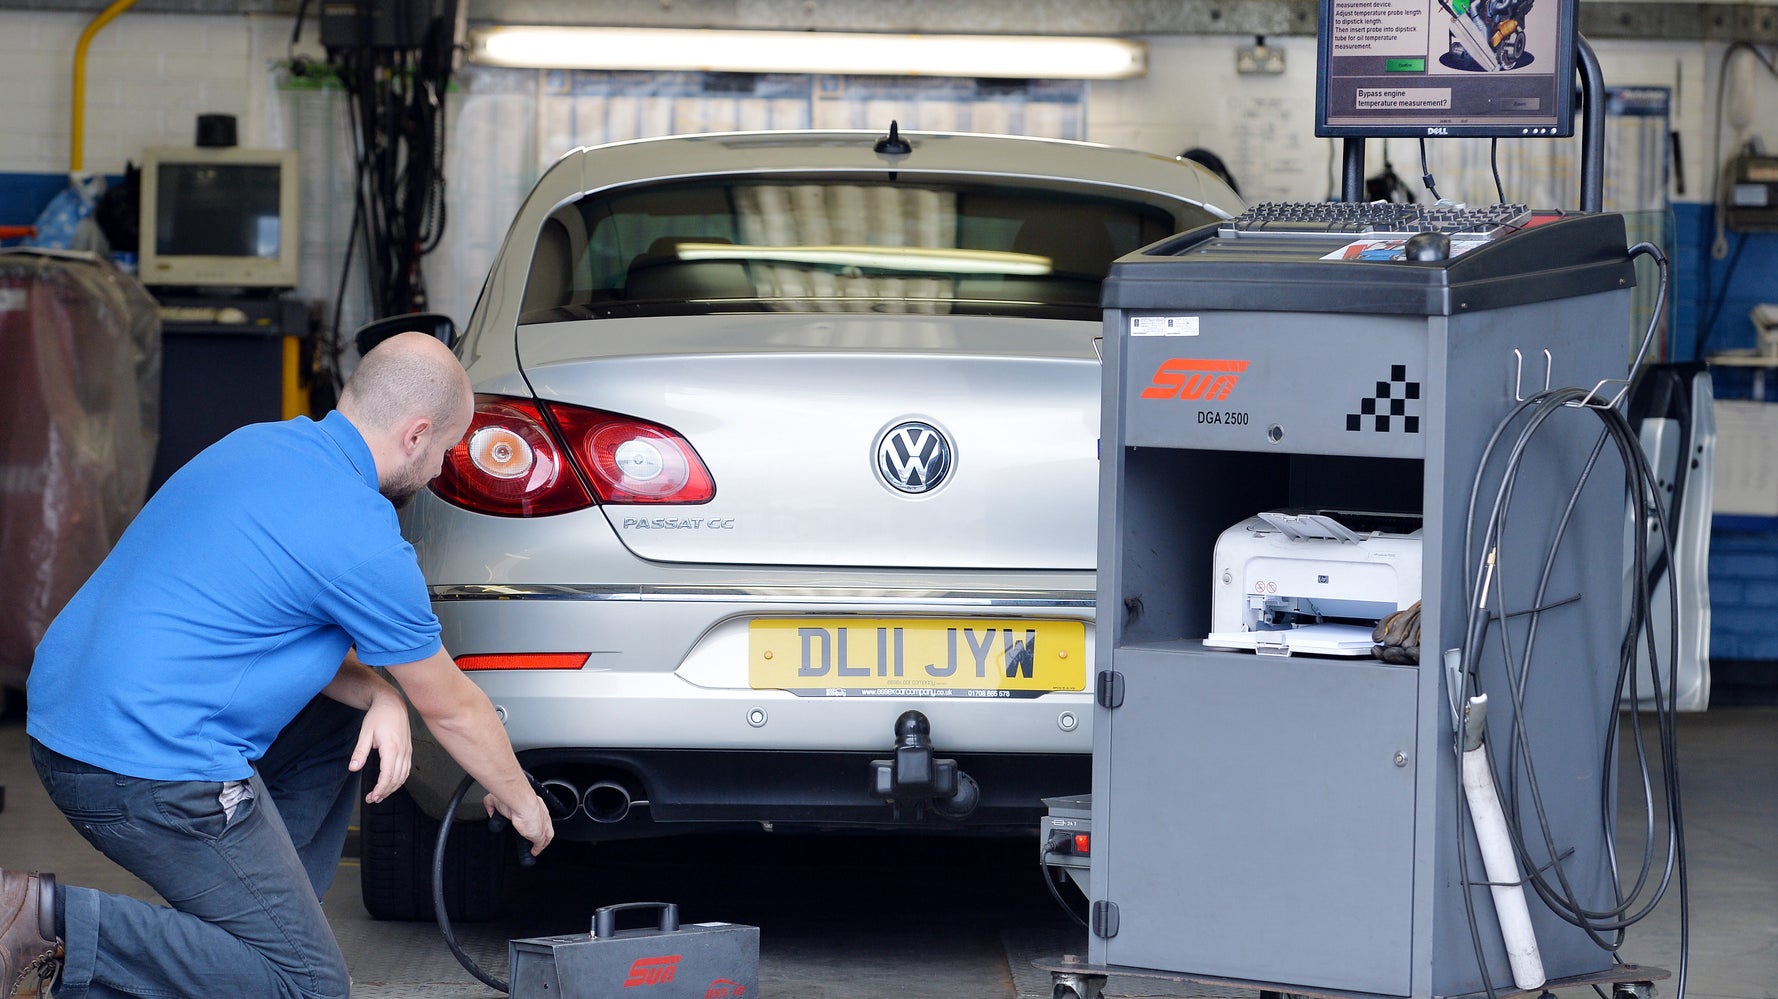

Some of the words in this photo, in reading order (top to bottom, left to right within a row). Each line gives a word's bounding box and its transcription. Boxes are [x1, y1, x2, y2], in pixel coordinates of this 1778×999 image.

[1358, 90, 1382, 99] Bypass
[1383, 90, 1406, 98] engine
[1427, 127, 1448, 135] DELL
[1197, 411, 1222, 425] DGA
[1224, 412, 1249, 426] 2500
[623, 517, 704, 529] PASSAT
[706, 517, 735, 529] CC
[797, 627, 904, 678] DL11
[924, 628, 1036, 679] JYW
[861, 688, 953, 697] www.essexcarcompany.co.uk
